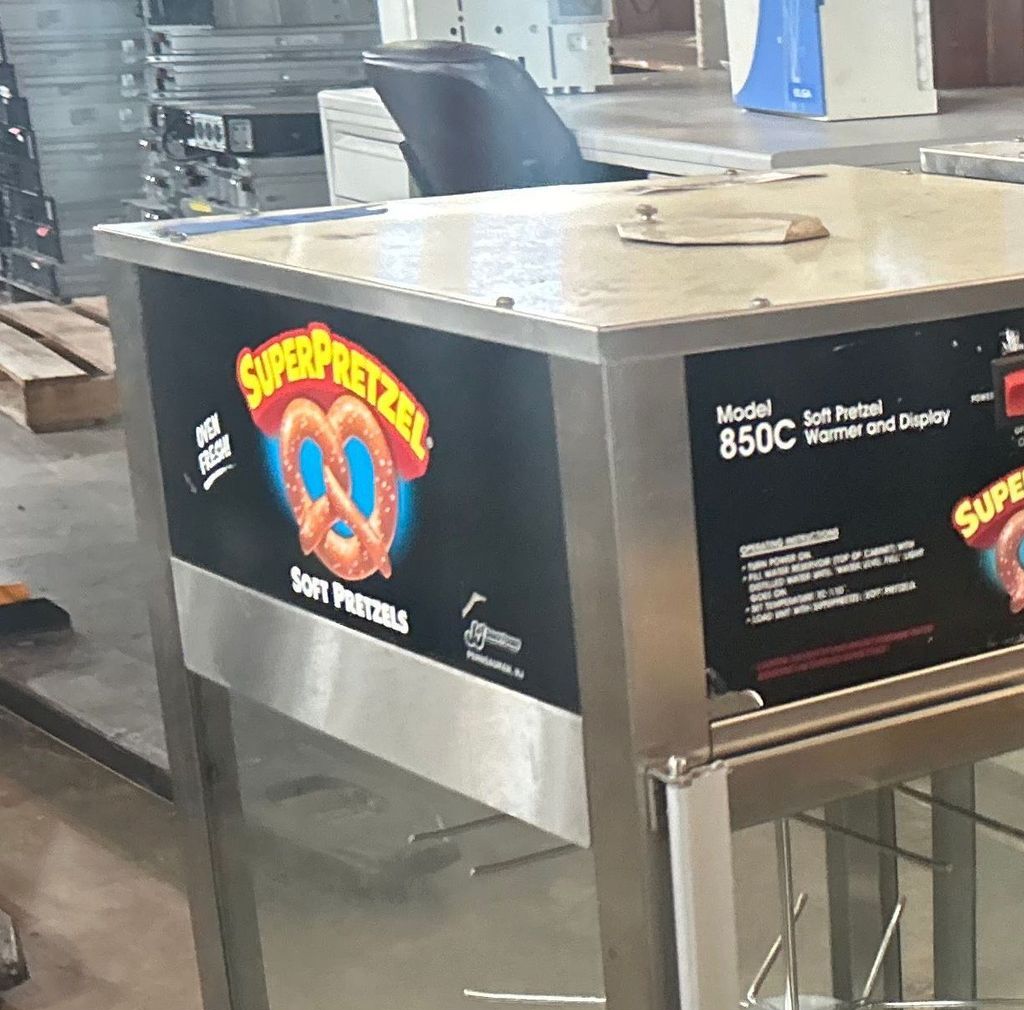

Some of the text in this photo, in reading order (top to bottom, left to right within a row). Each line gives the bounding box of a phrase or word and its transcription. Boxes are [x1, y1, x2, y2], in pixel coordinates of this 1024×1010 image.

[239, 328, 427, 461] SUPERPRETZEL
[716, 398, 773, 425] Model
[802, 399, 883, 427] Soft Pretzel
[196, 411, 221, 448] OVEN
[719, 418, 797, 461] 850C
[803, 408, 951, 446] Warmer and Display
[290, 565, 410, 634] SOFT PRETZELS
